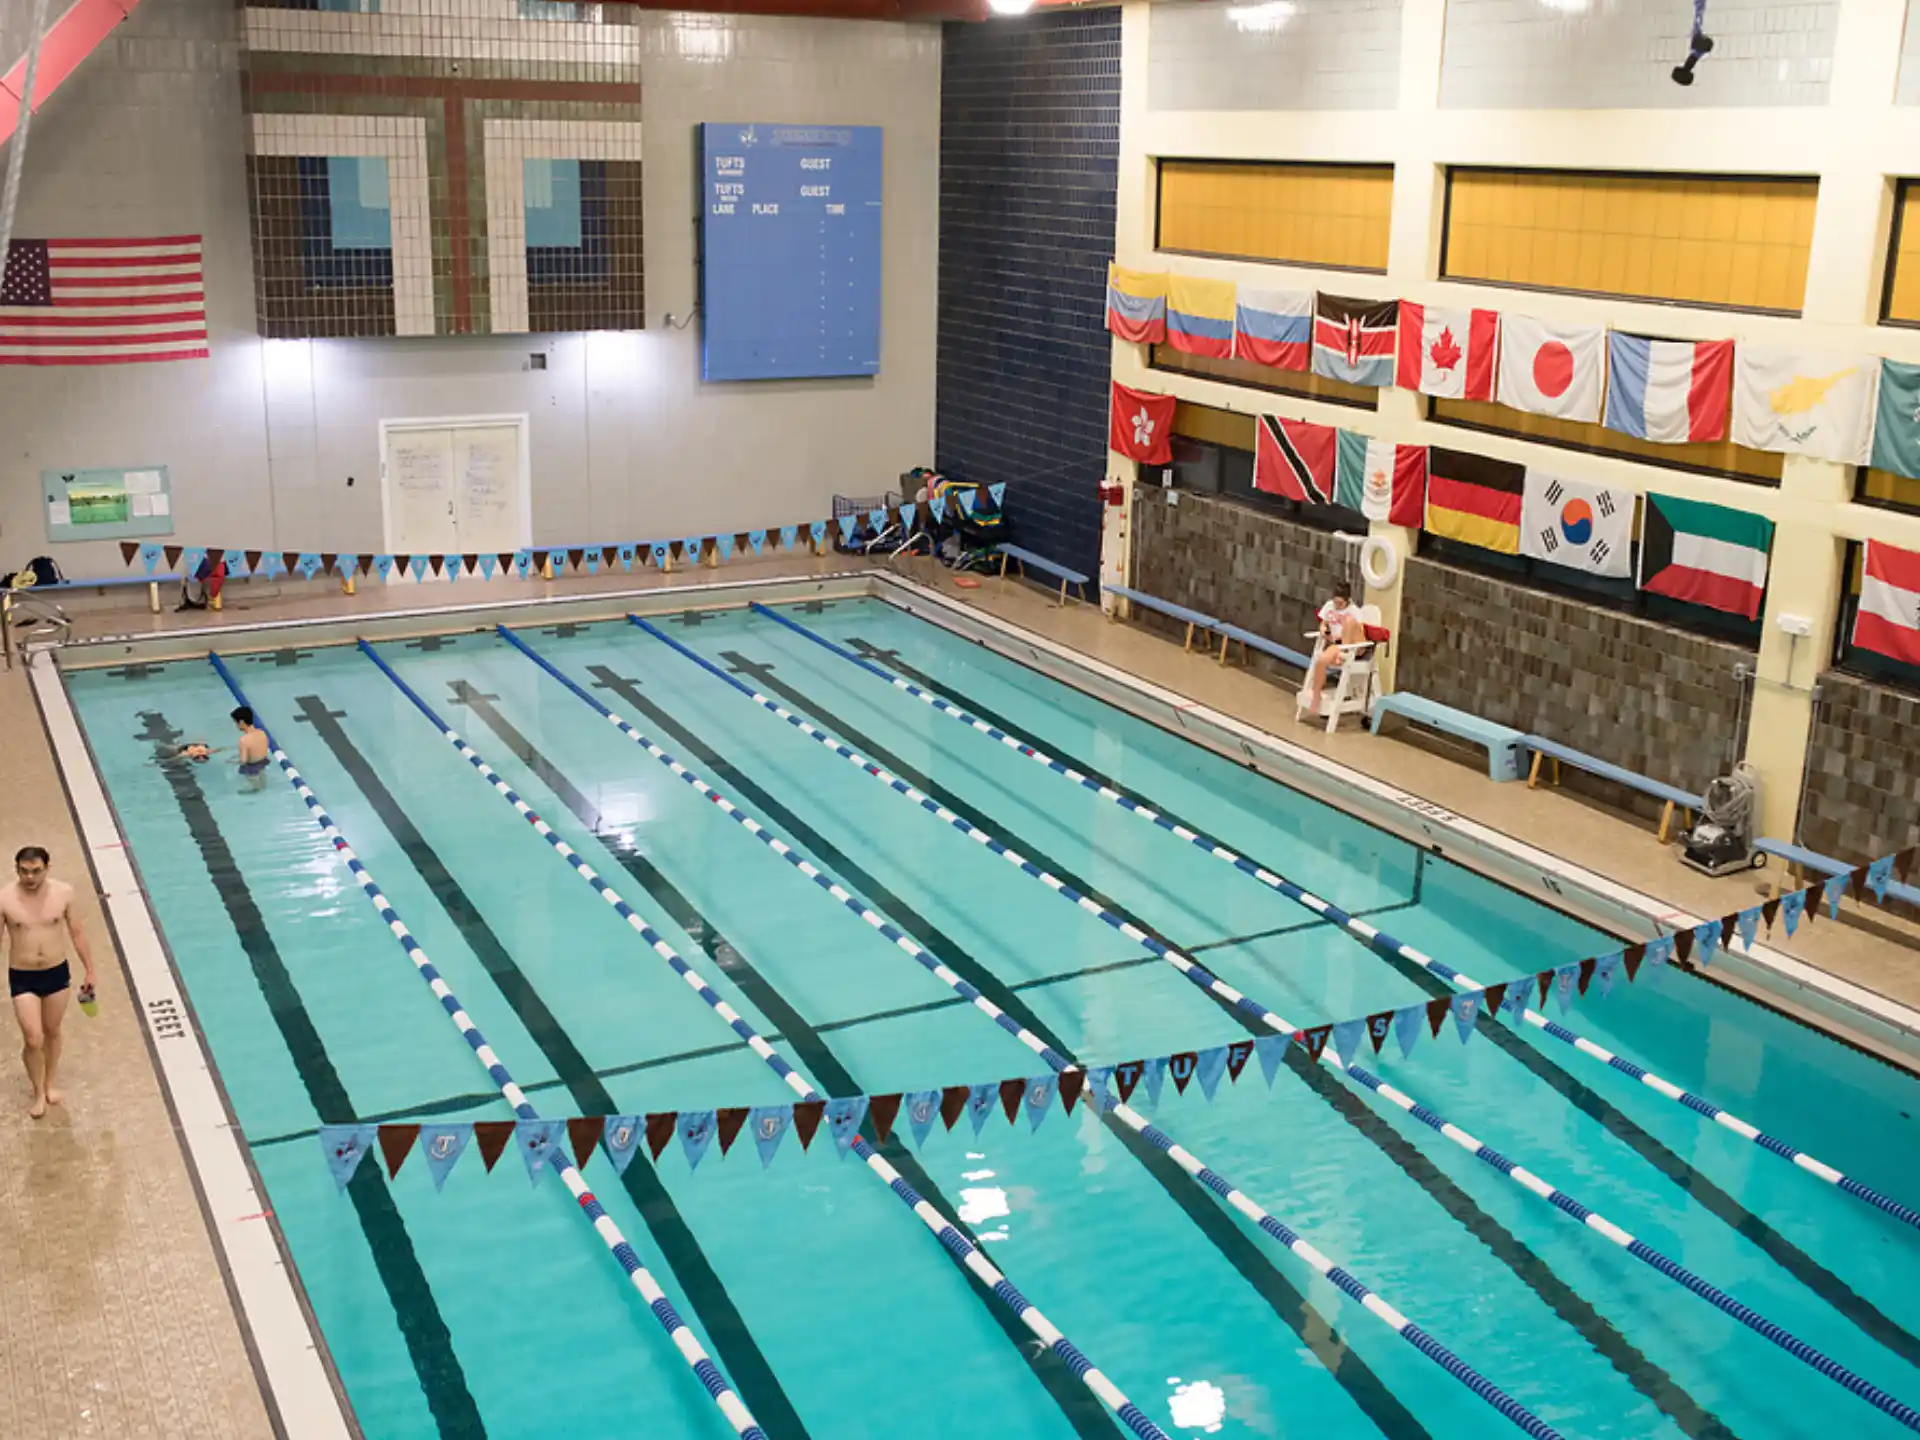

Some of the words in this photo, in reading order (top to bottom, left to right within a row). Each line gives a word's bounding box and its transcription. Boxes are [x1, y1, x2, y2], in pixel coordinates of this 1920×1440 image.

[715, 156, 745, 169] TUFTS
[800, 158, 831, 169] GUEST
[715, 183, 745, 195] TUFTS
[800, 185, 830, 197] GUEST
[752, 204, 779, 214] PLACE
